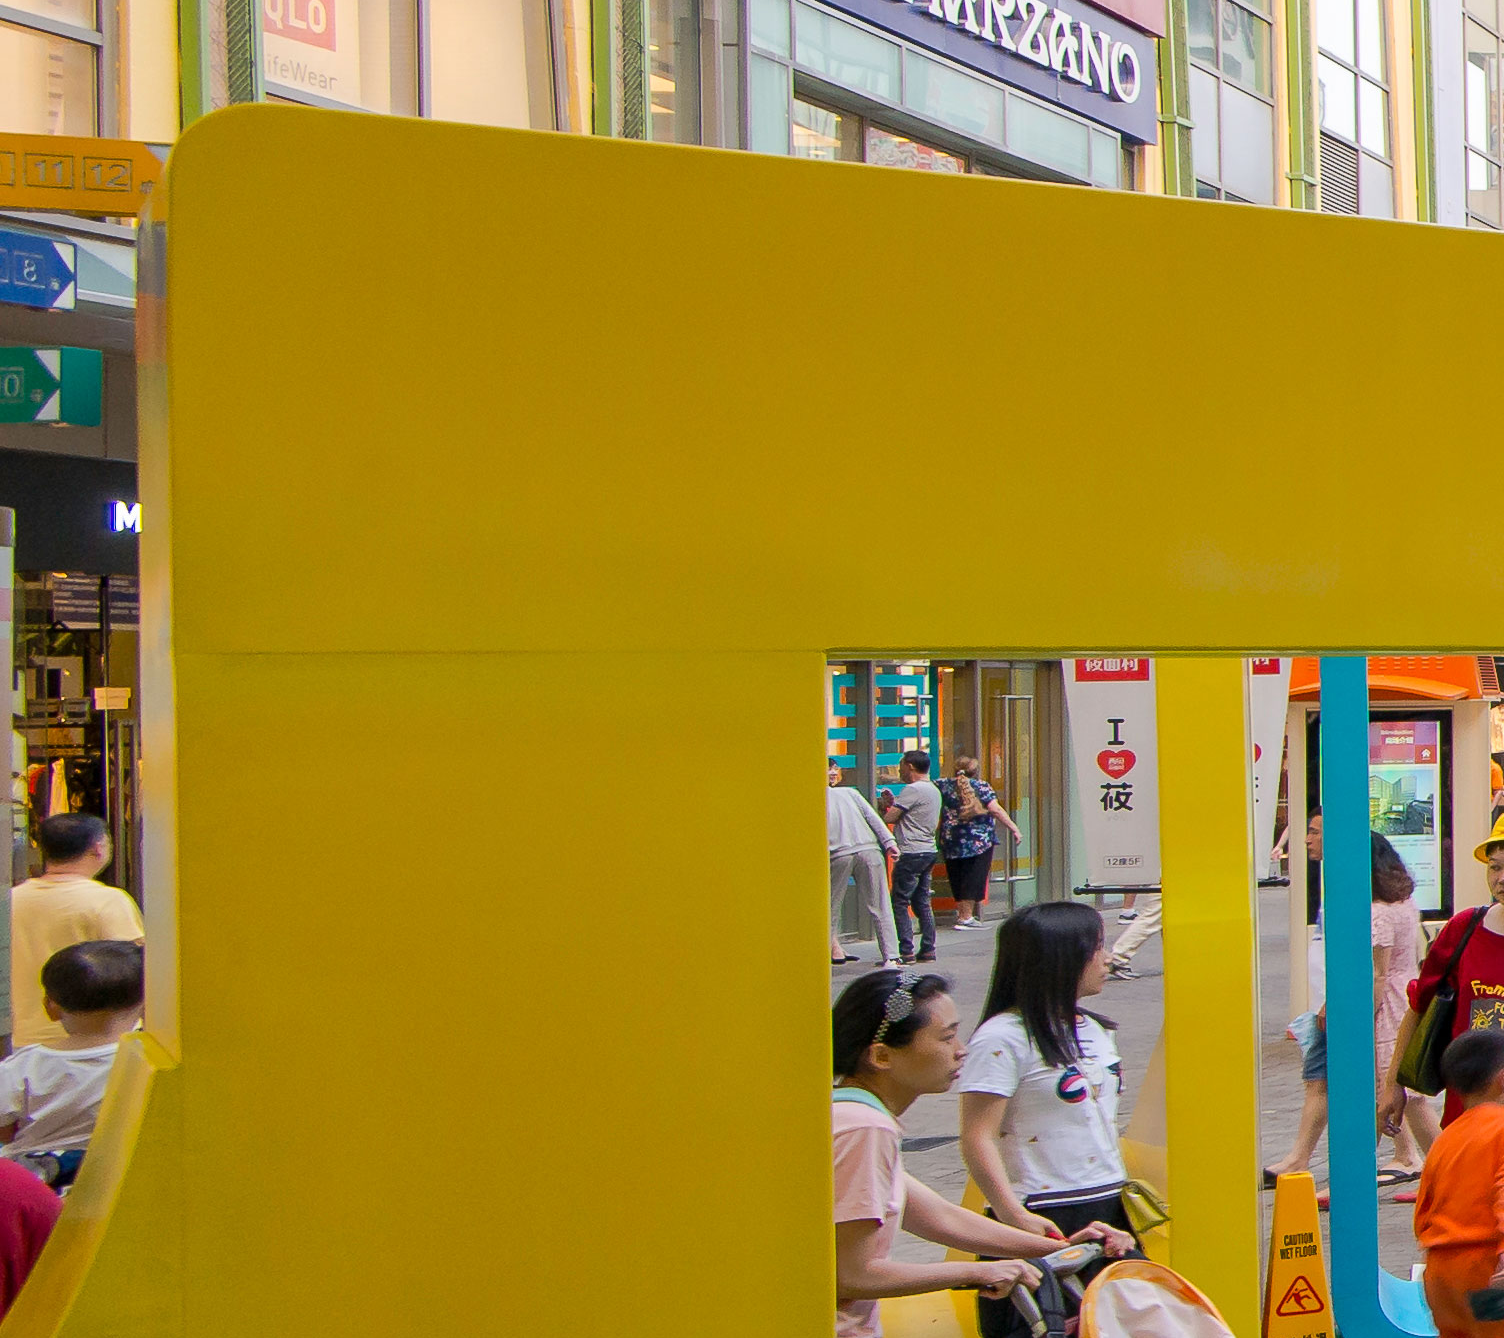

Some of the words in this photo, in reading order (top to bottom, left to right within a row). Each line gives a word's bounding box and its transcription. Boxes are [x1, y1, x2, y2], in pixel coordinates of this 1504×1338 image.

[263, 54, 338, 92] ifeWear
[33, 160, 64, 183] 11
[90, 164, 130, 189] 12
[23, 259, 38, 282] 8
[1283, 1232, 1314, 1247] CAUTION
[1279, 1247, 1294, 1260] WET
[1295, 1244, 1318, 1258] FLOOR
